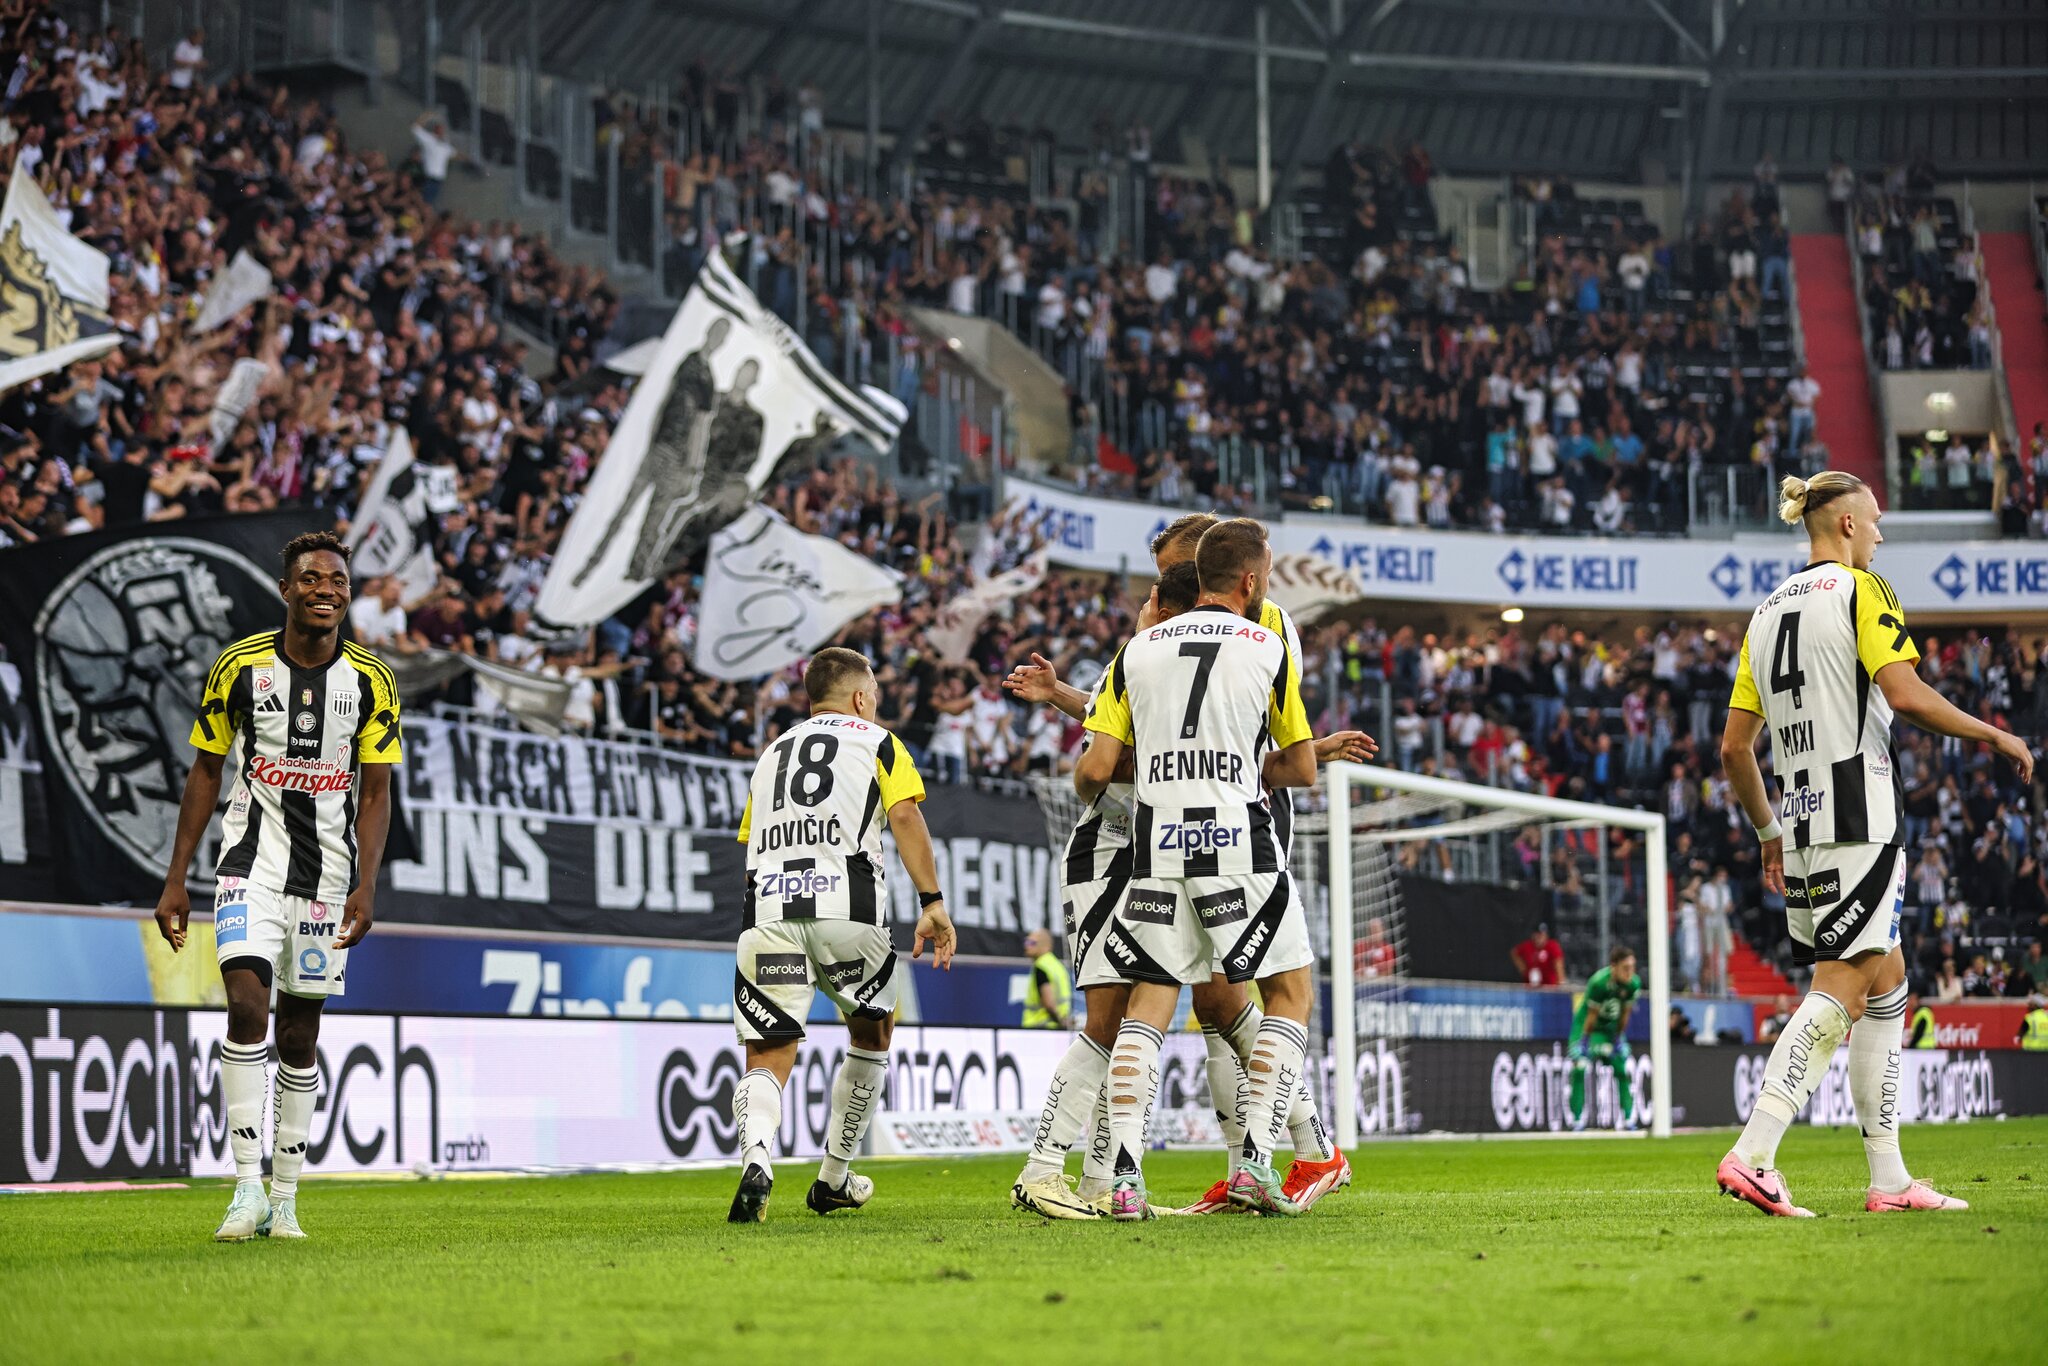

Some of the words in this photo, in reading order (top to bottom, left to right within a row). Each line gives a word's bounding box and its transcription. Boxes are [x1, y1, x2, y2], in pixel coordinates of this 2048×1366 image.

[1377, 546, 1436, 583] KELIT
[1533, 552, 1564, 590] KE
[1572, 554, 1638, 593] KELIT
[1752, 559, 1783, 594] KE
[1978, 559, 2013, 593] KE
[1759, 580, 1813, 616] ENERGIE
[1812, 578, 1838, 592] AG
[1149, 624, 1235, 642] ENERGIE
[1235, 628, 1267, 643] AG
[1771, 610, 1805, 710] 4
[334, 691, 353, 701] LASK
[1178, 641, 1222, 740] 7
[299, 739, 319, 748] BWT
[842, 720, 869, 732] AG
[248, 756, 355, 798] Kornspitz
[279, 756, 334, 771] backaldrin
[450, 726, 574, 817] NACH
[588, 744, 753, 832] HÜTTEL
[772, 734, 839, 813] 18
[1148, 750, 1243, 785] RENNER
[1782, 786, 1825, 827] Zipfer
[757, 813, 841, 855] JOVIČIĆ
[1158, 821, 1243, 858] Zipfer
[217, 888, 247, 908] BWT
[594, 822, 715, 913] DIE
[882, 830, 1063, 937] NDERV
[761, 869, 841, 902] Zipfer
[1784, 885, 1807, 900] obet
[216, 915, 246, 933] HYPO
[1129, 900, 1174, 916] nerobet
[1201, 898, 1245, 918] nerobet
[1831, 898, 1866, 936] BWT
[299, 921, 336, 937] BWT
[1242, 921, 1270, 959] BWT
[1106, 931, 1138, 967] BWT
[760, 963, 806, 976] nerobet
[859, 979, 881, 1001] WT
[746, 999, 779, 1029] BWT
[1782, 1043, 1809, 1095] MOLTO
[1801, 1018, 1827, 1051] LUCE
[1280, 1063, 1297, 1100] LUCE
[1878, 1079, 1898, 1131] MOLTO
[1888, 1048, 1902, 1080] LUCE
[839, 1110, 863, 1153] MOLTO
[854, 1081, 876, 1113] LUCE
[1033, 1108, 1055, 1154] MOLTO
[1049, 1072, 1068, 1110] LUCE
[445, 1134, 490, 1168] gmbh
[1091, 1117, 1110, 1166] MOLTO
[1312, 1124, 1331, 1161] TAPEDESIGN
